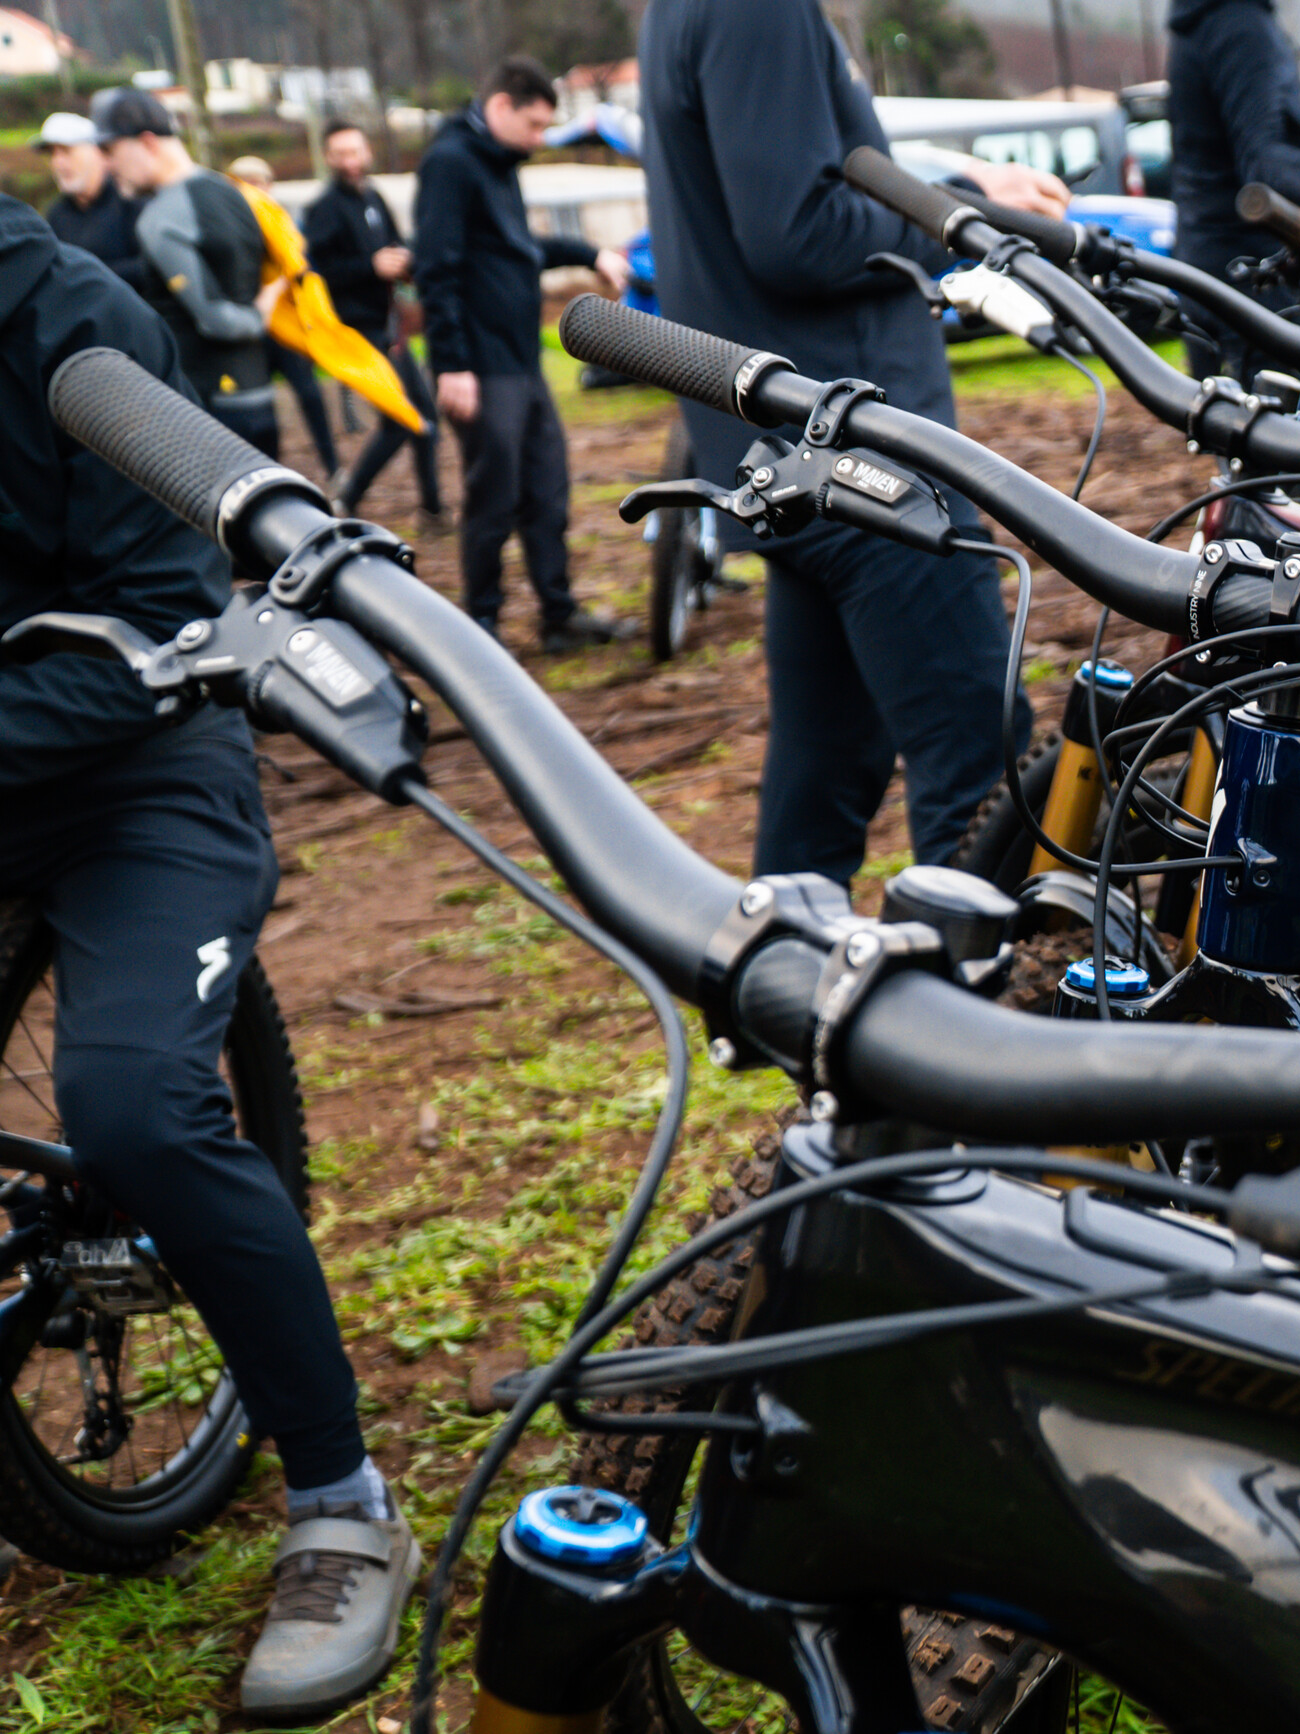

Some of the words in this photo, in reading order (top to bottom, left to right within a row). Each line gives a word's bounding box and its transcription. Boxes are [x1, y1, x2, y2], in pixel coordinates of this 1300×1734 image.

[853, 461, 900, 496] MAVEN
[1193, 570, 1207, 593] NINE
[1189, 594, 1201, 640] NDUSTRY
